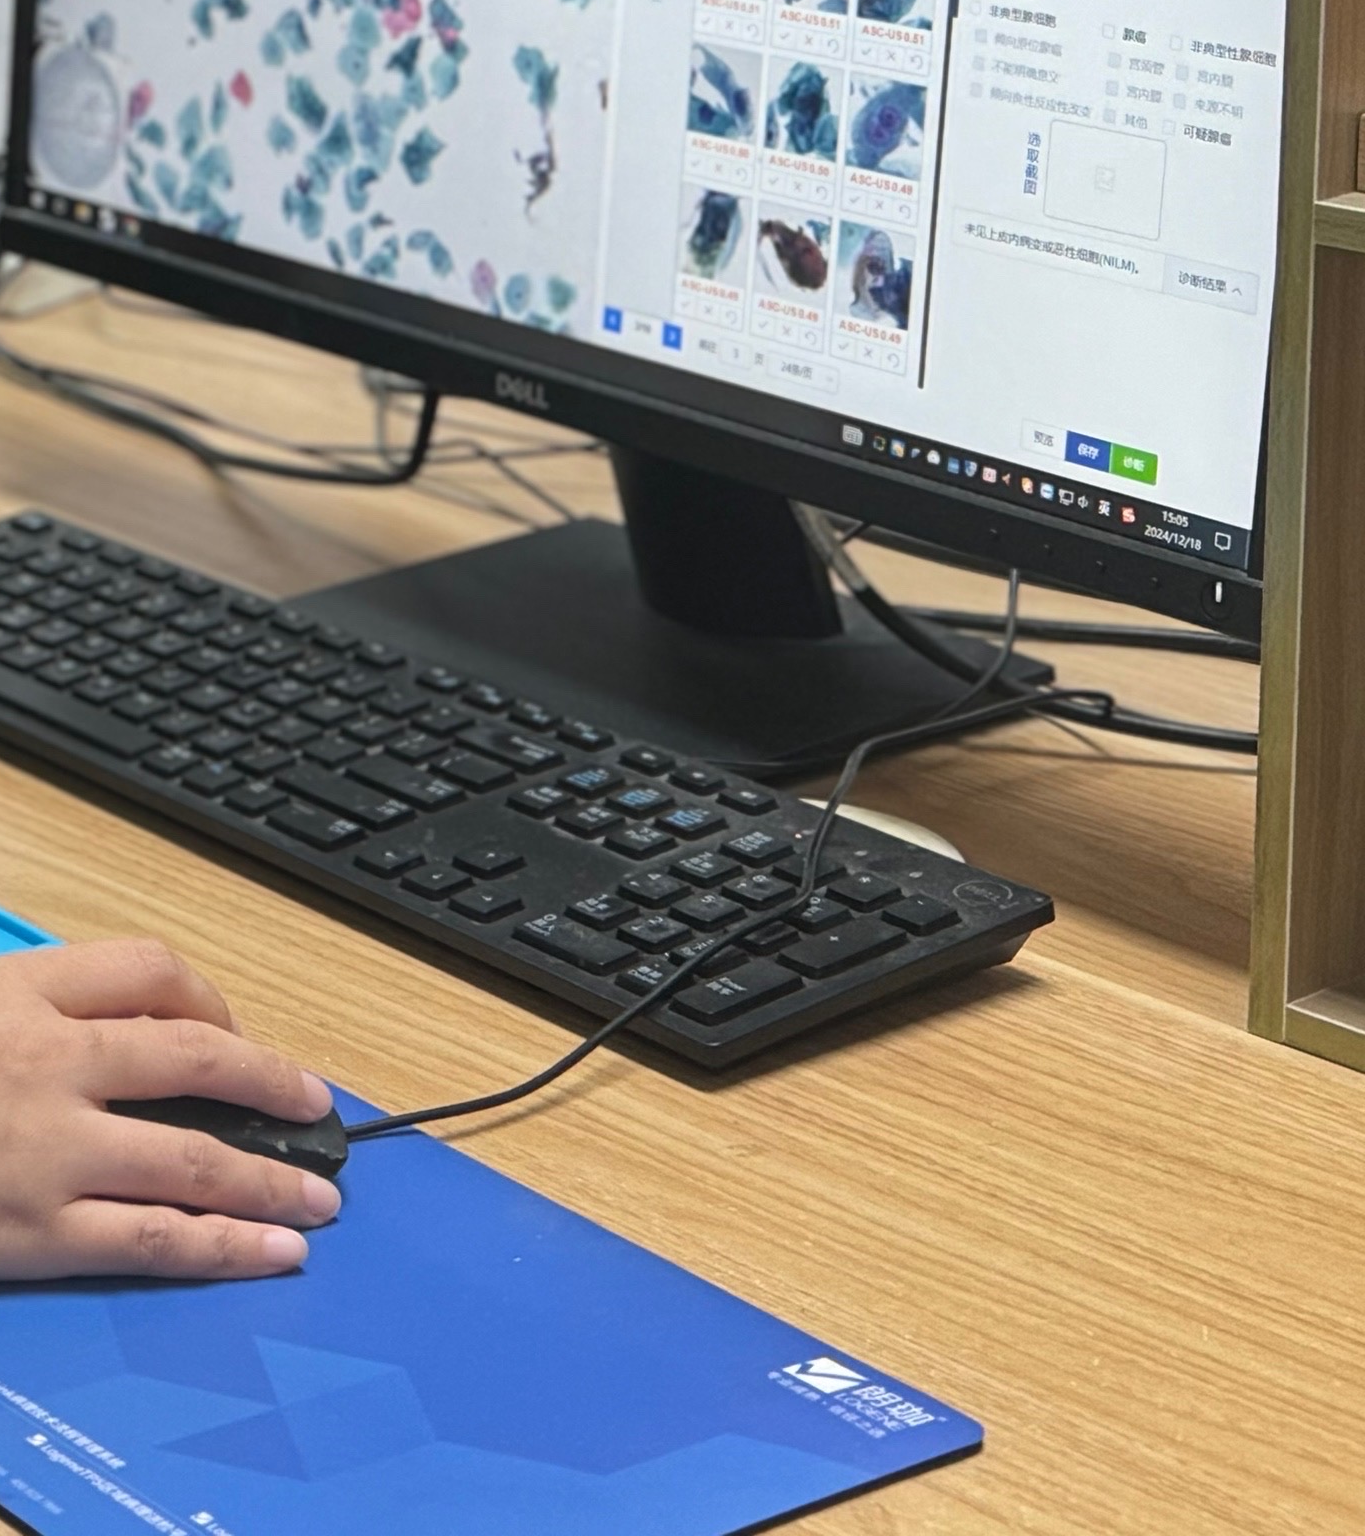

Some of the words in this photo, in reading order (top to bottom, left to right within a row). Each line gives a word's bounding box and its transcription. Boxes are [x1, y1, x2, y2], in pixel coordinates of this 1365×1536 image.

[780, 9, 819, 26] ASC-US
[988, 4, 1057, 29] 非典型腺细胞
[862, 24, 903, 42] ASC-US
[904, 32, 925, 45] 0.51
[1122, 27, 1147, 45] 腺癌
[1190, 40, 1278, 68] 非典型性腺细胞
[1183, 123, 1233, 147] 可疑腺癌
[769, 154, 809, 172] ASC-US
[1023, 131, 1042, 196] 选取截图
[850, 172, 891, 191] ASC-US
[1178, 270, 1227, 294] 诊断结果
[758, 298, 797, 317] ASC-US
[839, 319, 879, 339] ASC-US
[496, 371, 550, 411] DELL
[1098, 500, 1111, 517] 英
[1161, 510, 1189, 528] 15:05
[1144, 524, 1202, 552] 2024/12/18
